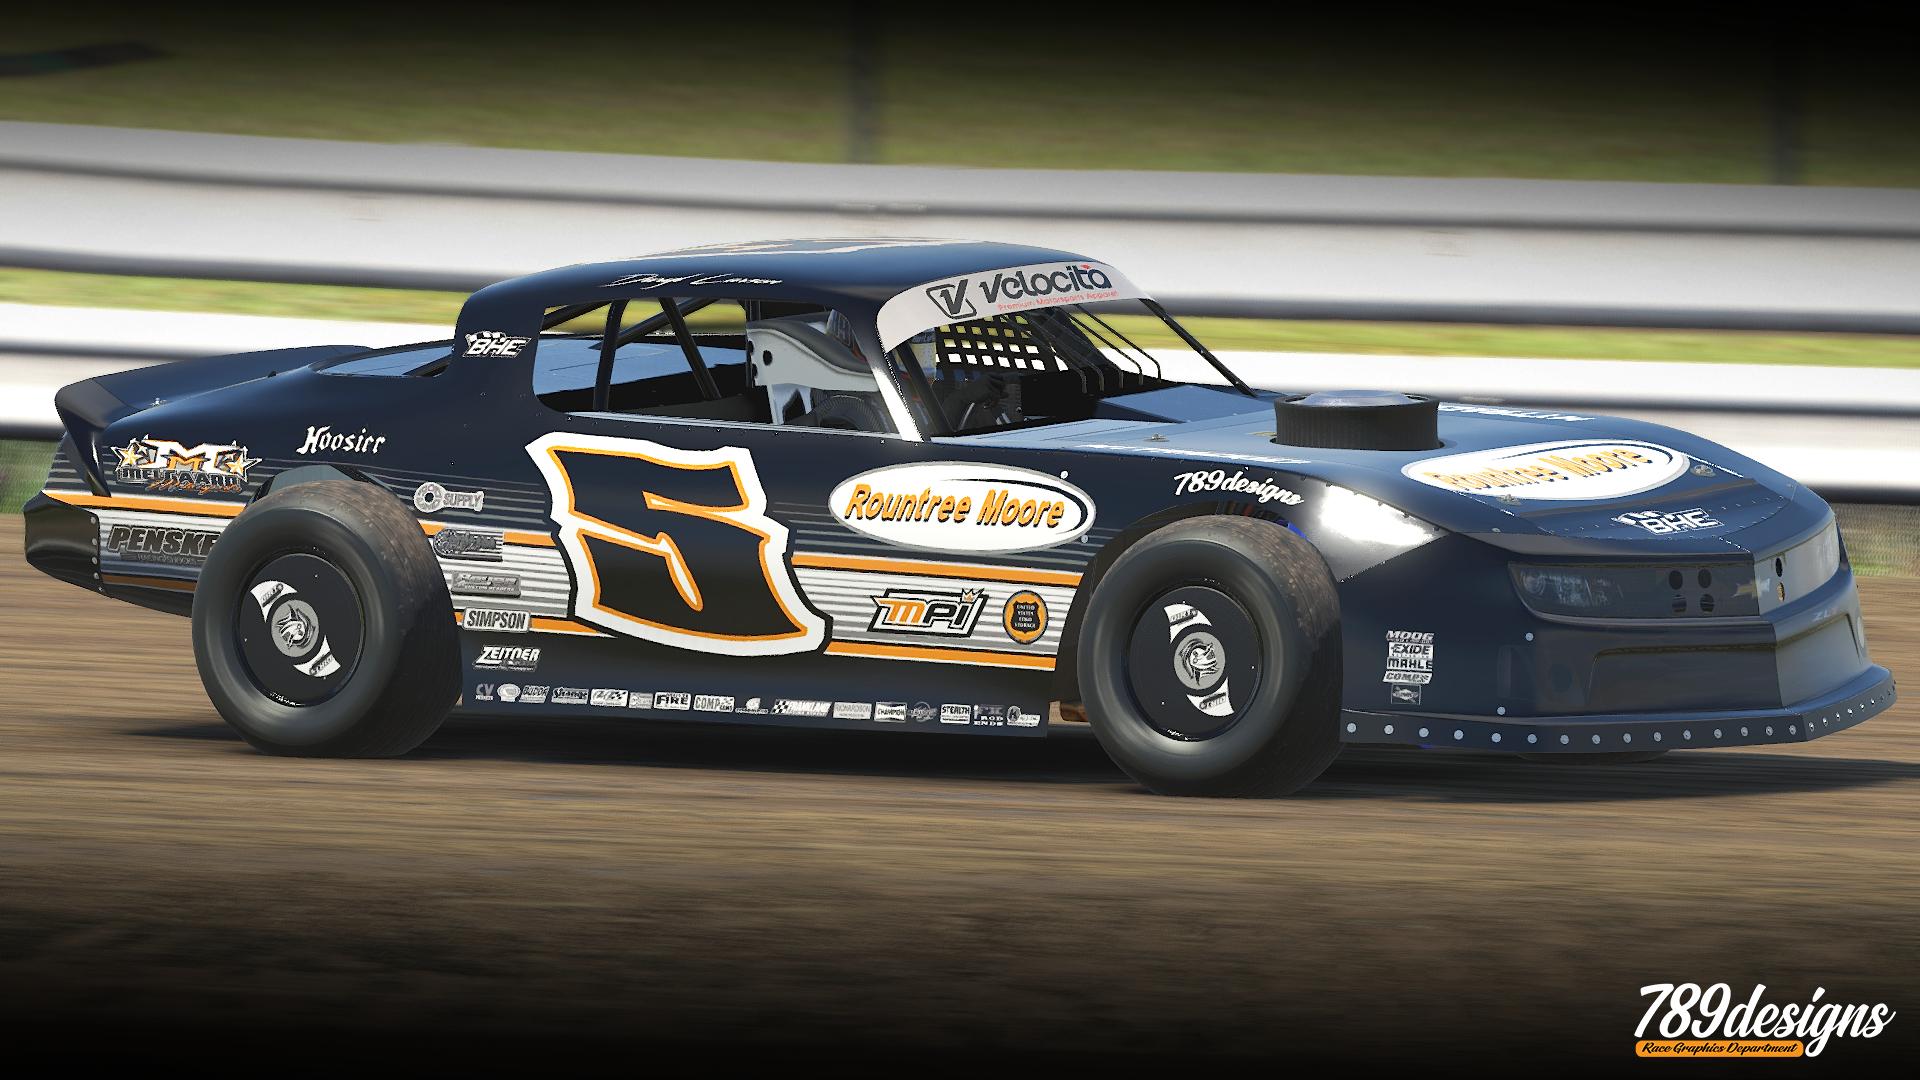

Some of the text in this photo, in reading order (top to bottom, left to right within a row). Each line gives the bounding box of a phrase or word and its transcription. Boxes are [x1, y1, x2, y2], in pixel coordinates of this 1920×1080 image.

[1174, 469, 1305, 506] 789designs
[443, 491, 485, 511] SUPPLY
[844, 483, 1065, 528] Rountree Moore
[533, 437, 820, 650] 5
[466, 610, 526, 630] SIMPSON
[1386, 630, 1434, 641] MOOG
[475, 646, 541, 665] ZEITNER
[1391, 643, 1431, 655] EXIDE
[1387, 658, 1433, 670] MAHLE
[695, 696, 721, 709] COMP
[941, 705, 970, 715] STEALTH
